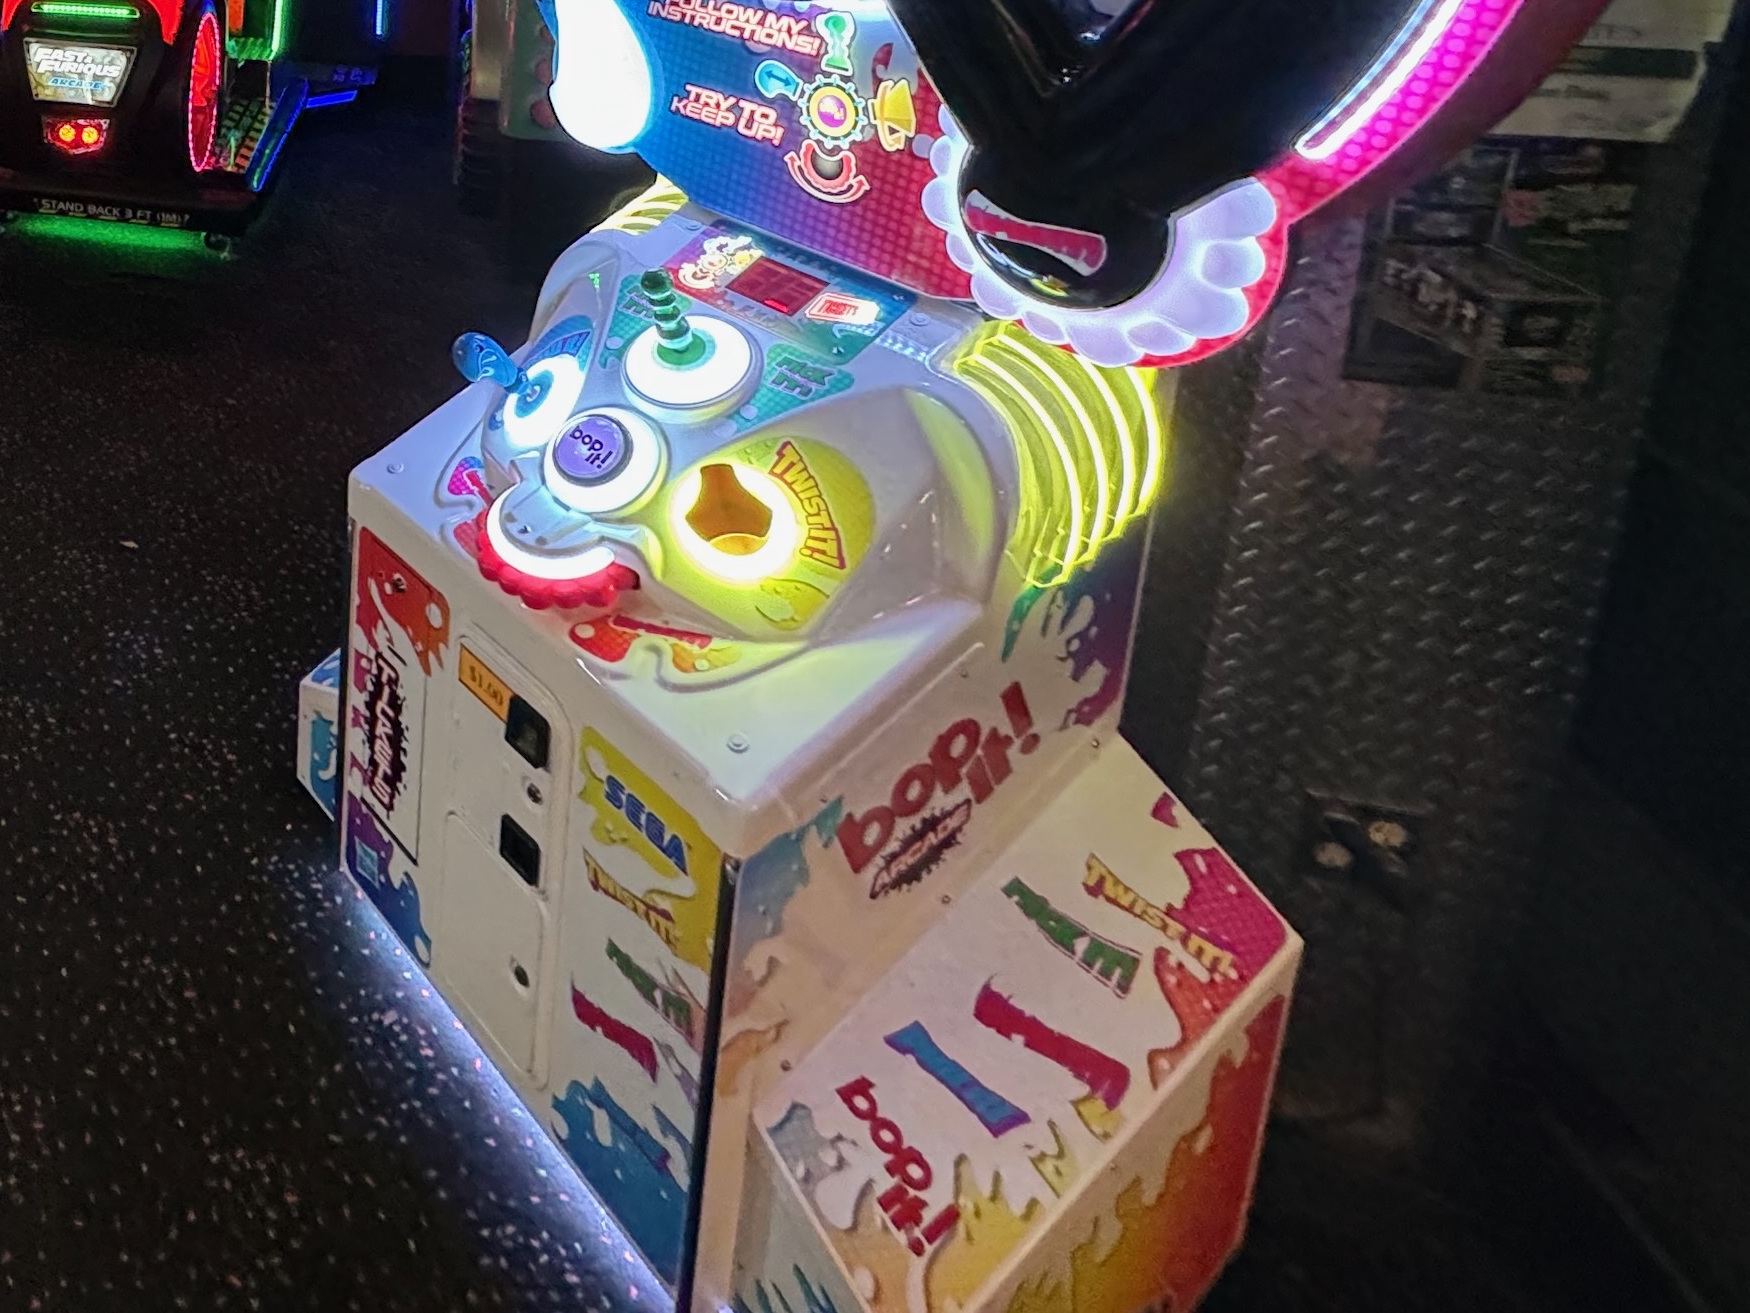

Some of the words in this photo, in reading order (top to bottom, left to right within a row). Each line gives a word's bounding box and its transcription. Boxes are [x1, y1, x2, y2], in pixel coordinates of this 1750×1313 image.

[648, 0, 822, 57] INSTRUCTIONS!
[764, 10, 809, 36] MY
[33, 47, 88, 62] FAST
[37, 60, 123, 78] FURIOUS
[670, 95, 737, 128] KEEP
[737, 113, 785, 146] UP!
[685, 84, 737, 111] TRY
[737, 98, 779, 126] TO
[40, 198, 85, 212] STAND
[87, 203, 121, 217] BACK
[136, 209, 153, 220] FT
[569, 425, 605, 451] bop
[584, 449, 614, 471] it!
[768, 440, 834, 530] TWIST
[836, 718, 981, 874] bop
[966, 681, 1041, 805] it!
[604, 774, 690, 878] SEGA
[836, 1075, 933, 1191] bop
[876, 1182, 961, 1257] it!
